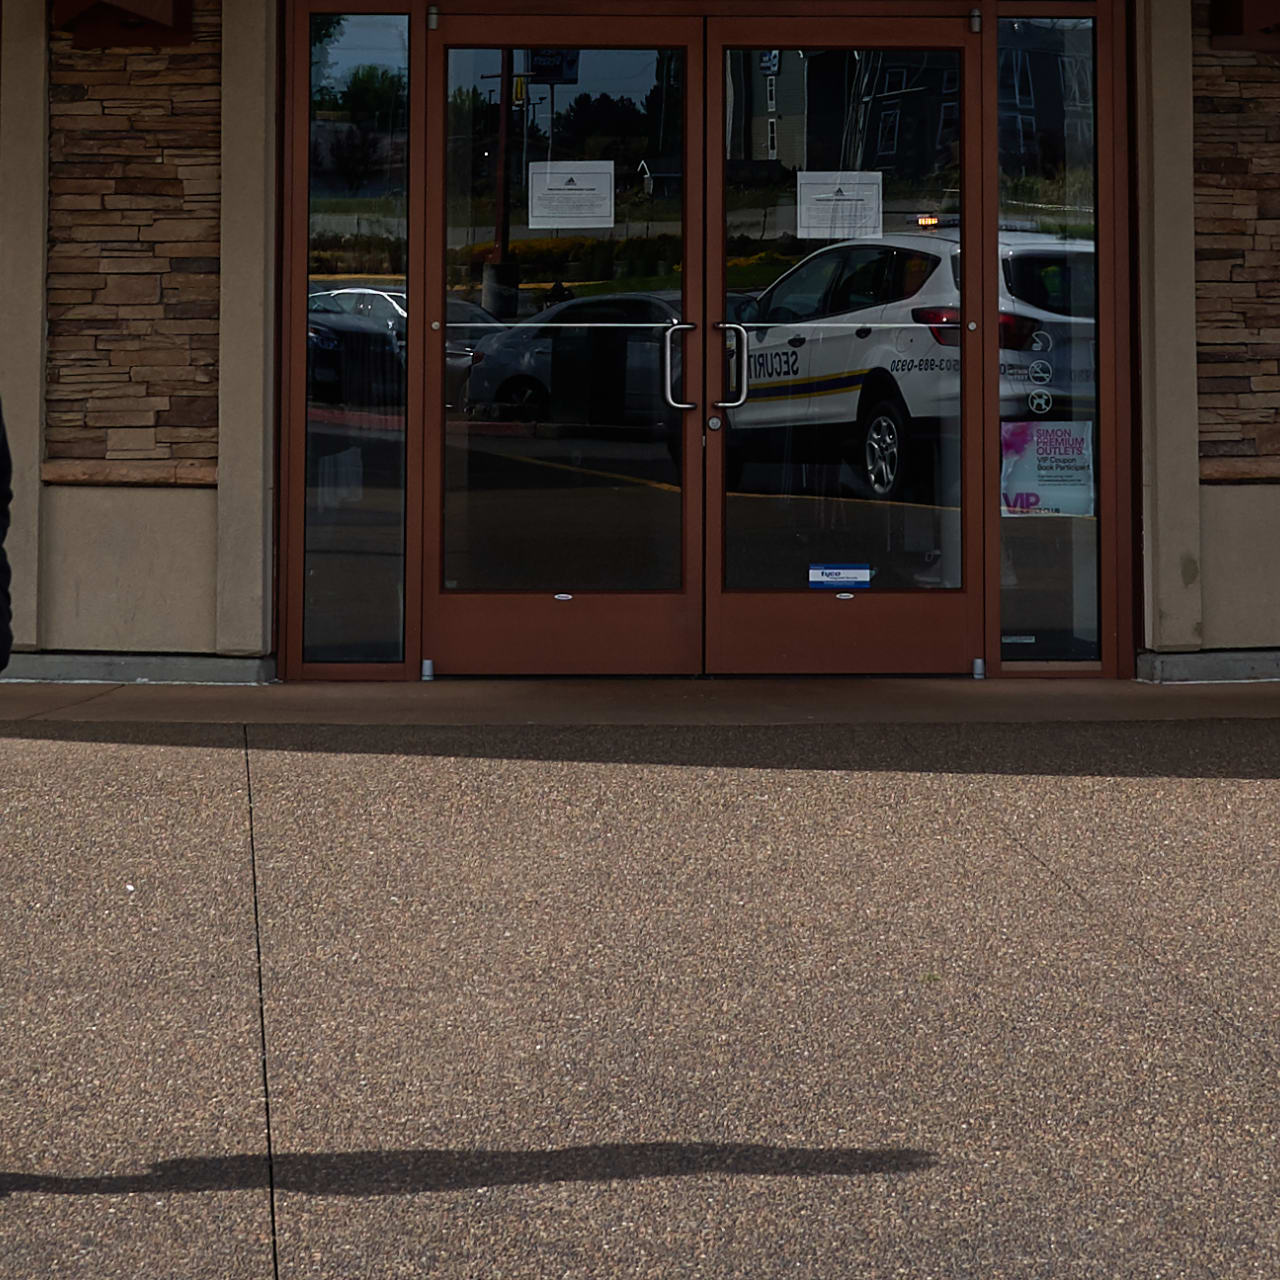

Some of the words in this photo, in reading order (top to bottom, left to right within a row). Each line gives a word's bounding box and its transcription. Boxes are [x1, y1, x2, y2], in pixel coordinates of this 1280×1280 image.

[1036, 428, 1072, 438] SIMON
[1036, 437, 1085, 447] PREMIUM
[1036, 446, 1083, 456] OUTLETS
[1050, 456, 1077, 465] Coupon
[1002, 492, 1041, 511] VIP
